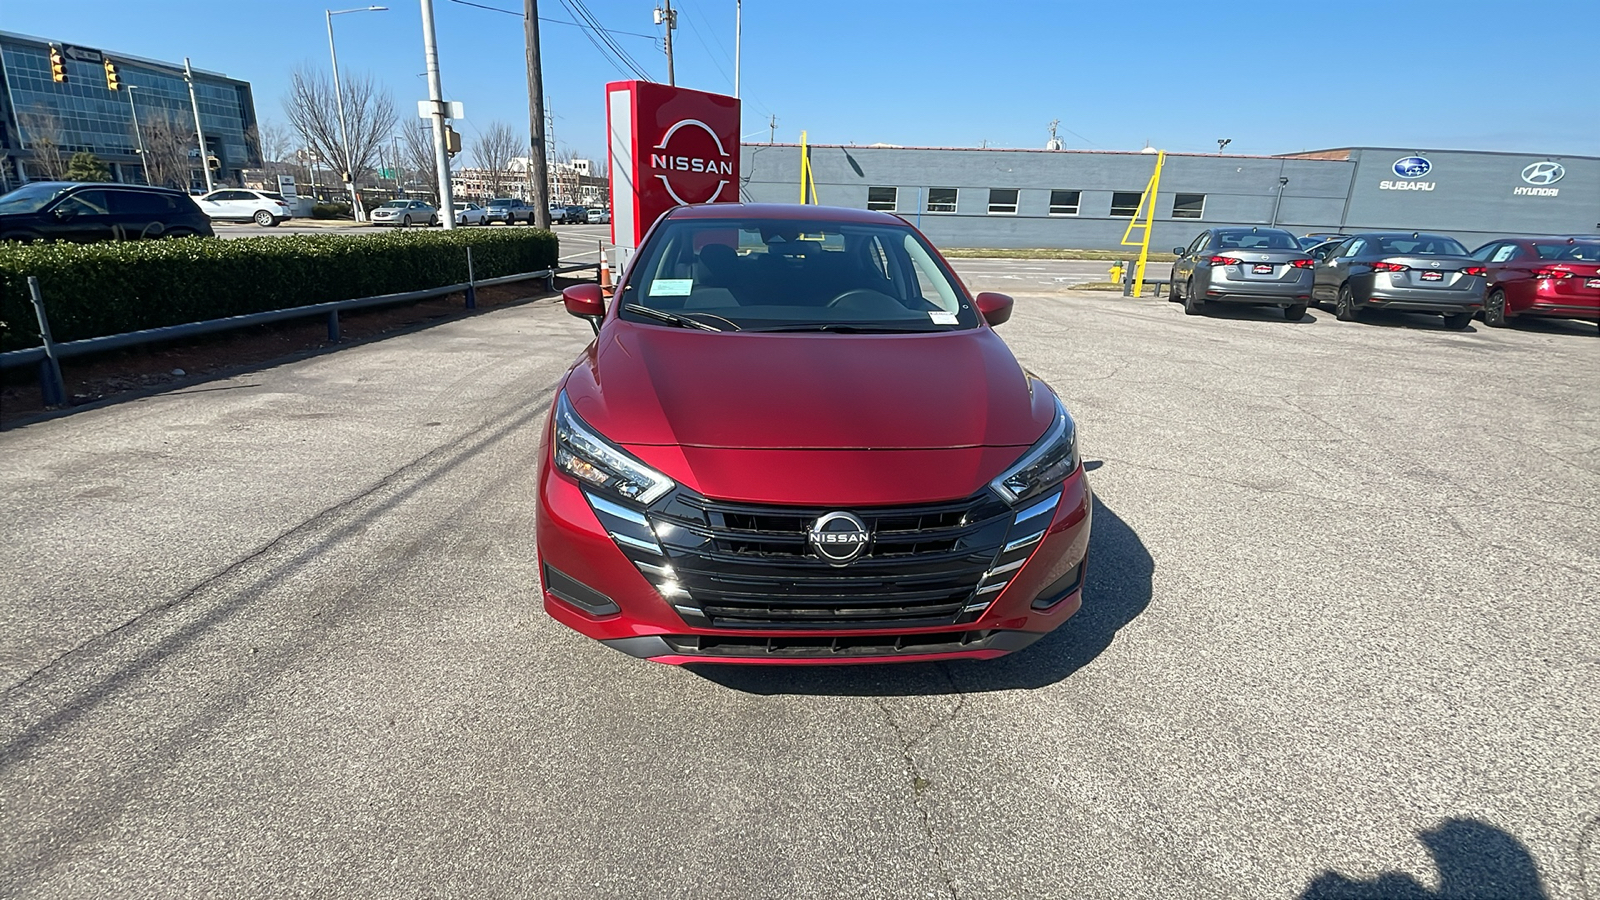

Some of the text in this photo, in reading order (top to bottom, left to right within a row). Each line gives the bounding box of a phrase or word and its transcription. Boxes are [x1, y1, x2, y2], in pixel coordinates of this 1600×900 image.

[651, 153, 732, 175] NISSAN
[1379, 180, 1436, 192] SUBARU
[1513, 186, 1559, 197] HYUNDAI
[810, 533, 869, 543] NISSAN
